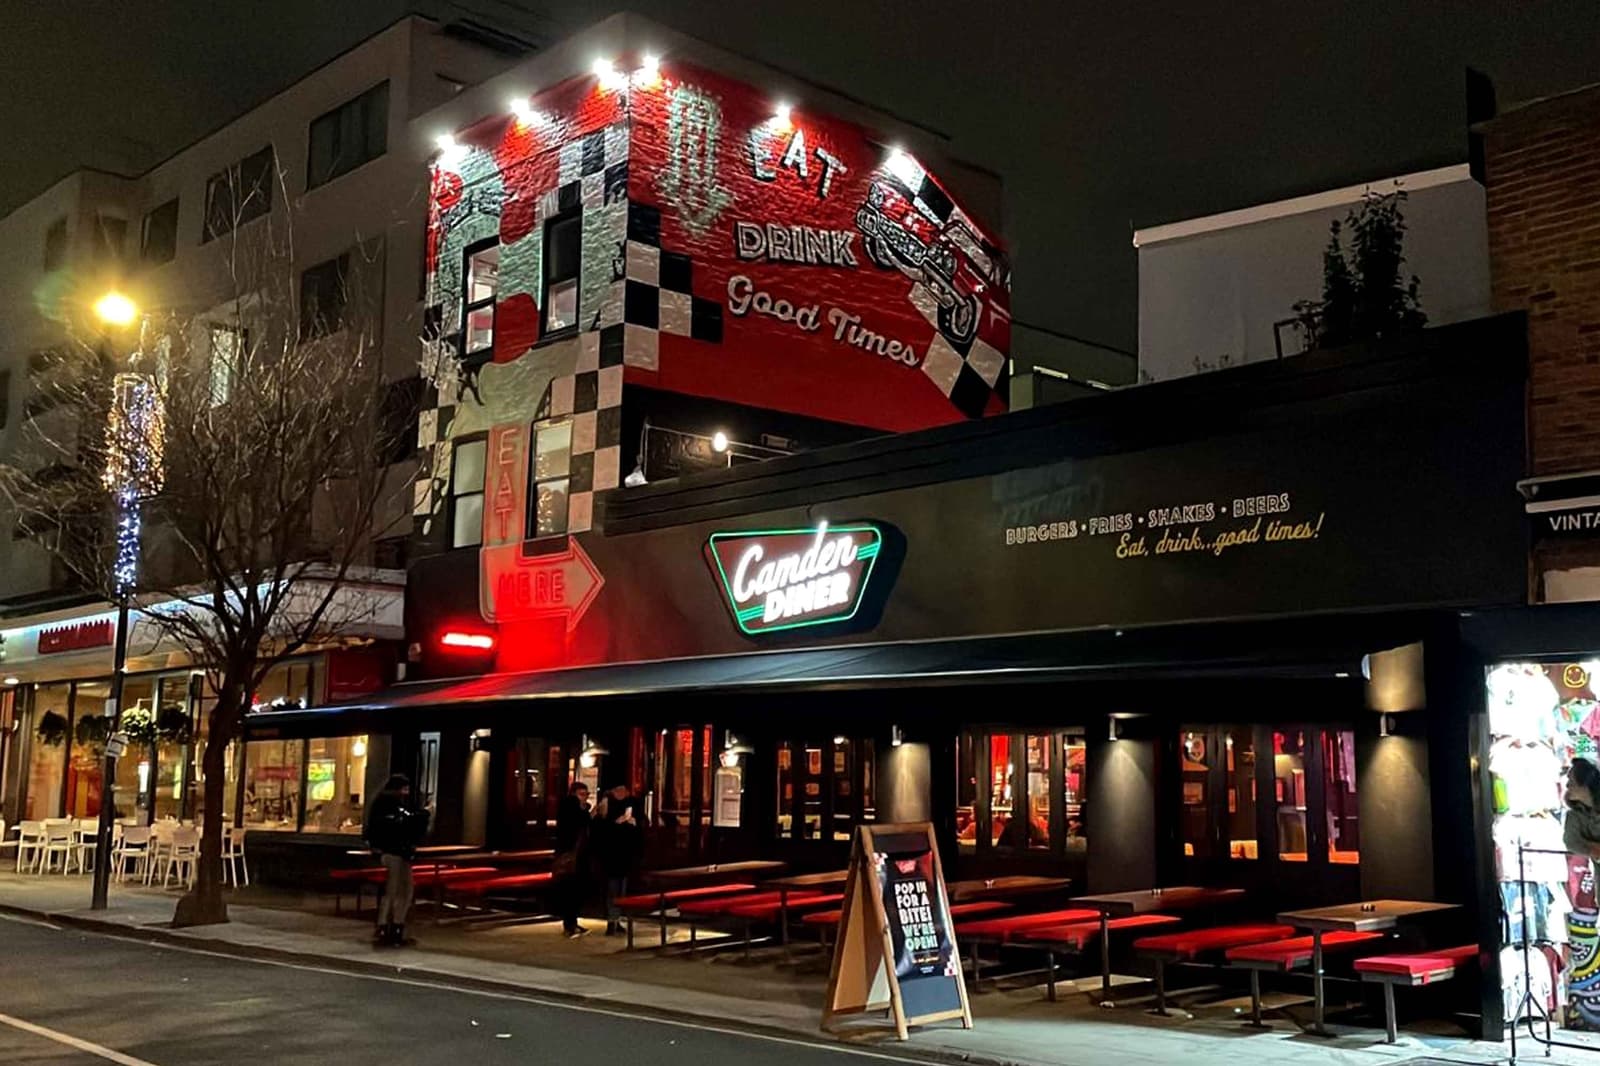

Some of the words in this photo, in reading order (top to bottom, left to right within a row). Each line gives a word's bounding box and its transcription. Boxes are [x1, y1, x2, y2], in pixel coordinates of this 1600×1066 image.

[747, 129, 847, 199] EAT
[735, 221, 857, 267] DRINK
[727, 275, 820, 332] Good
[828, 308, 919, 367] Times
[495, 428, 521, 538] EAT
[1006, 521, 1078, 545] BURGERS
[1089, 514, 1133, 535] FRIES
[1148, 503, 1216, 528] SHAKES
[1233, 493, 1291, 518] BEERS
[1116, 532, 1149, 559] Eat,
[1265, 513, 1325, 541] times!
[734, 519, 857, 602] Camden
[763, 572, 852, 623] DINER
[894, 882, 914, 895] POP
[896, 893, 919, 908] FOR
[921, 892, 930, 906] A
